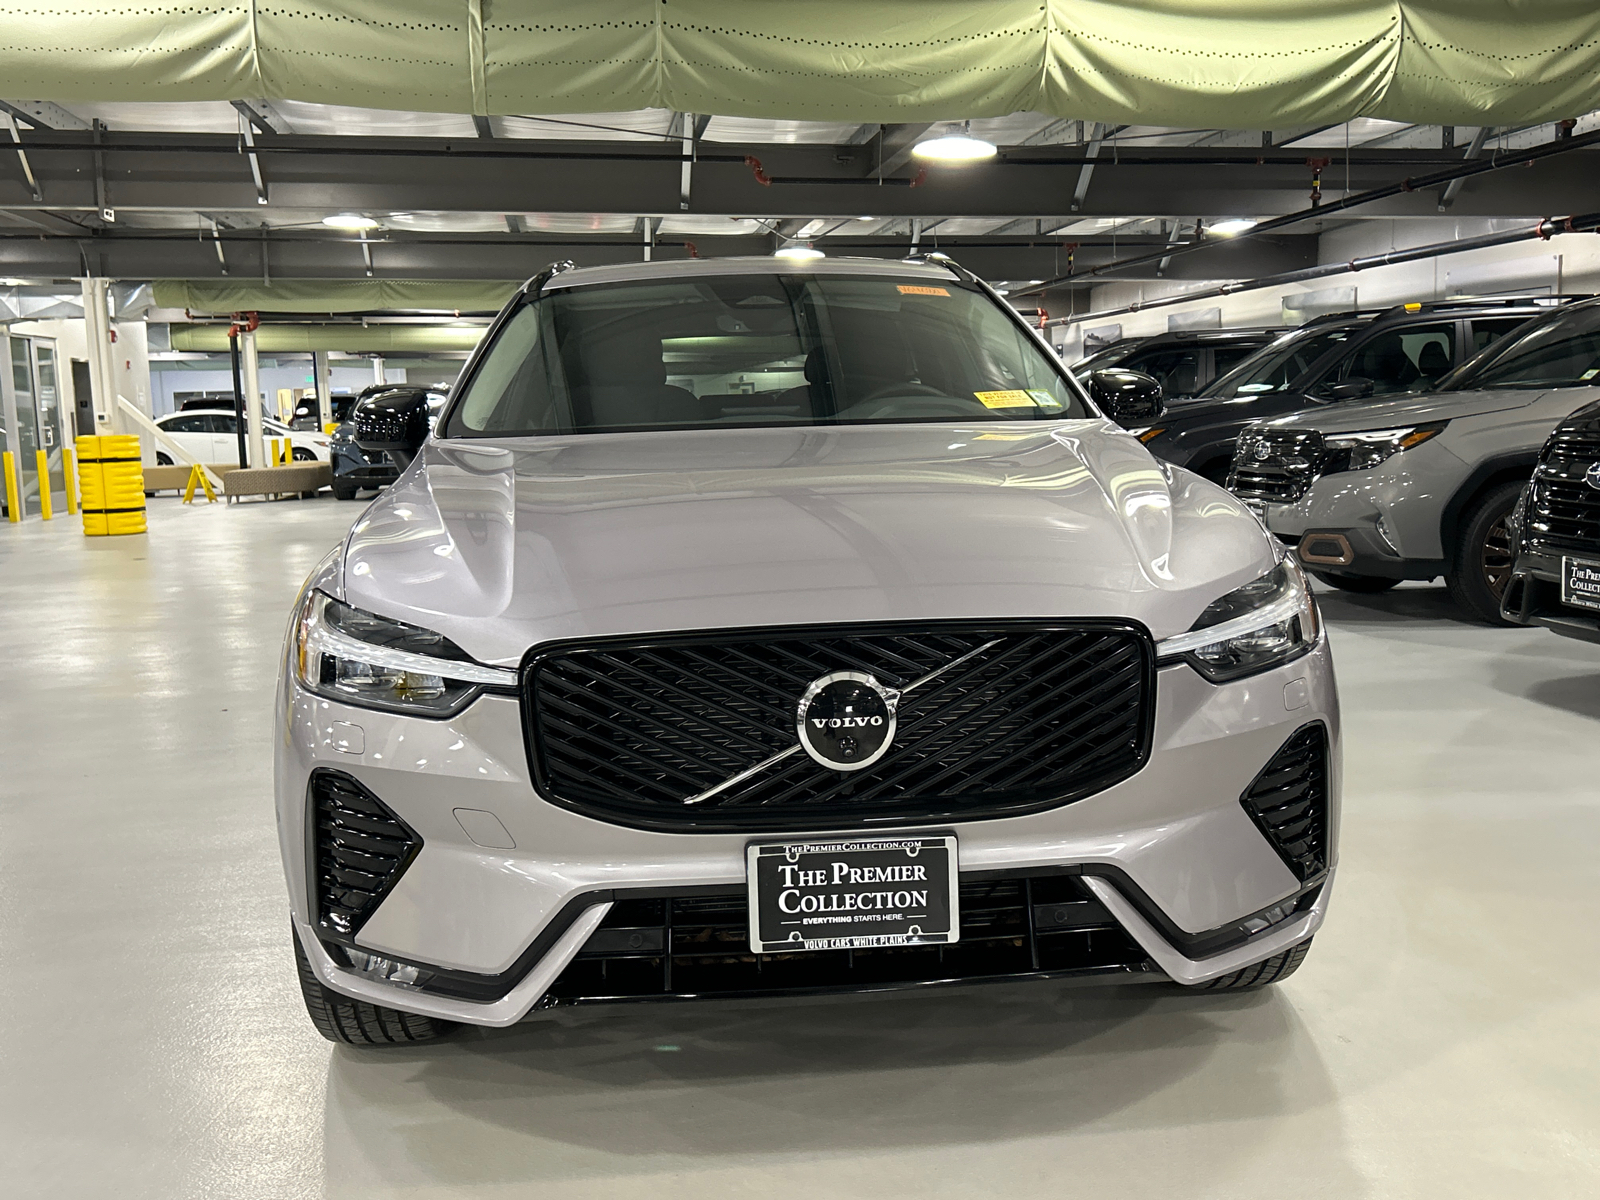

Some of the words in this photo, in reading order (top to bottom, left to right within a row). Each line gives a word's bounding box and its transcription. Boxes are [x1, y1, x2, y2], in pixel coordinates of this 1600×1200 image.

[1571, 566, 1585, 578] THE
[1586, 568, 1600, 580] PRE
[811, 716, 883, 728] VOLVO
[778, 864, 828, 888] THE
[831, 862, 928, 884] PREMIER
[778, 889, 928, 914] COLLECTION
[802, 916, 852, 925] EVERYTHING
[854, 914, 881, 922] STARTS
[882, 913, 904, 921] HERE.
[804, 939, 828, 950] VOLVO
[830, 938, 850, 948] CARS
[854, 937, 878, 946] WHITE
[880, 936, 908, 945] PLAINS
